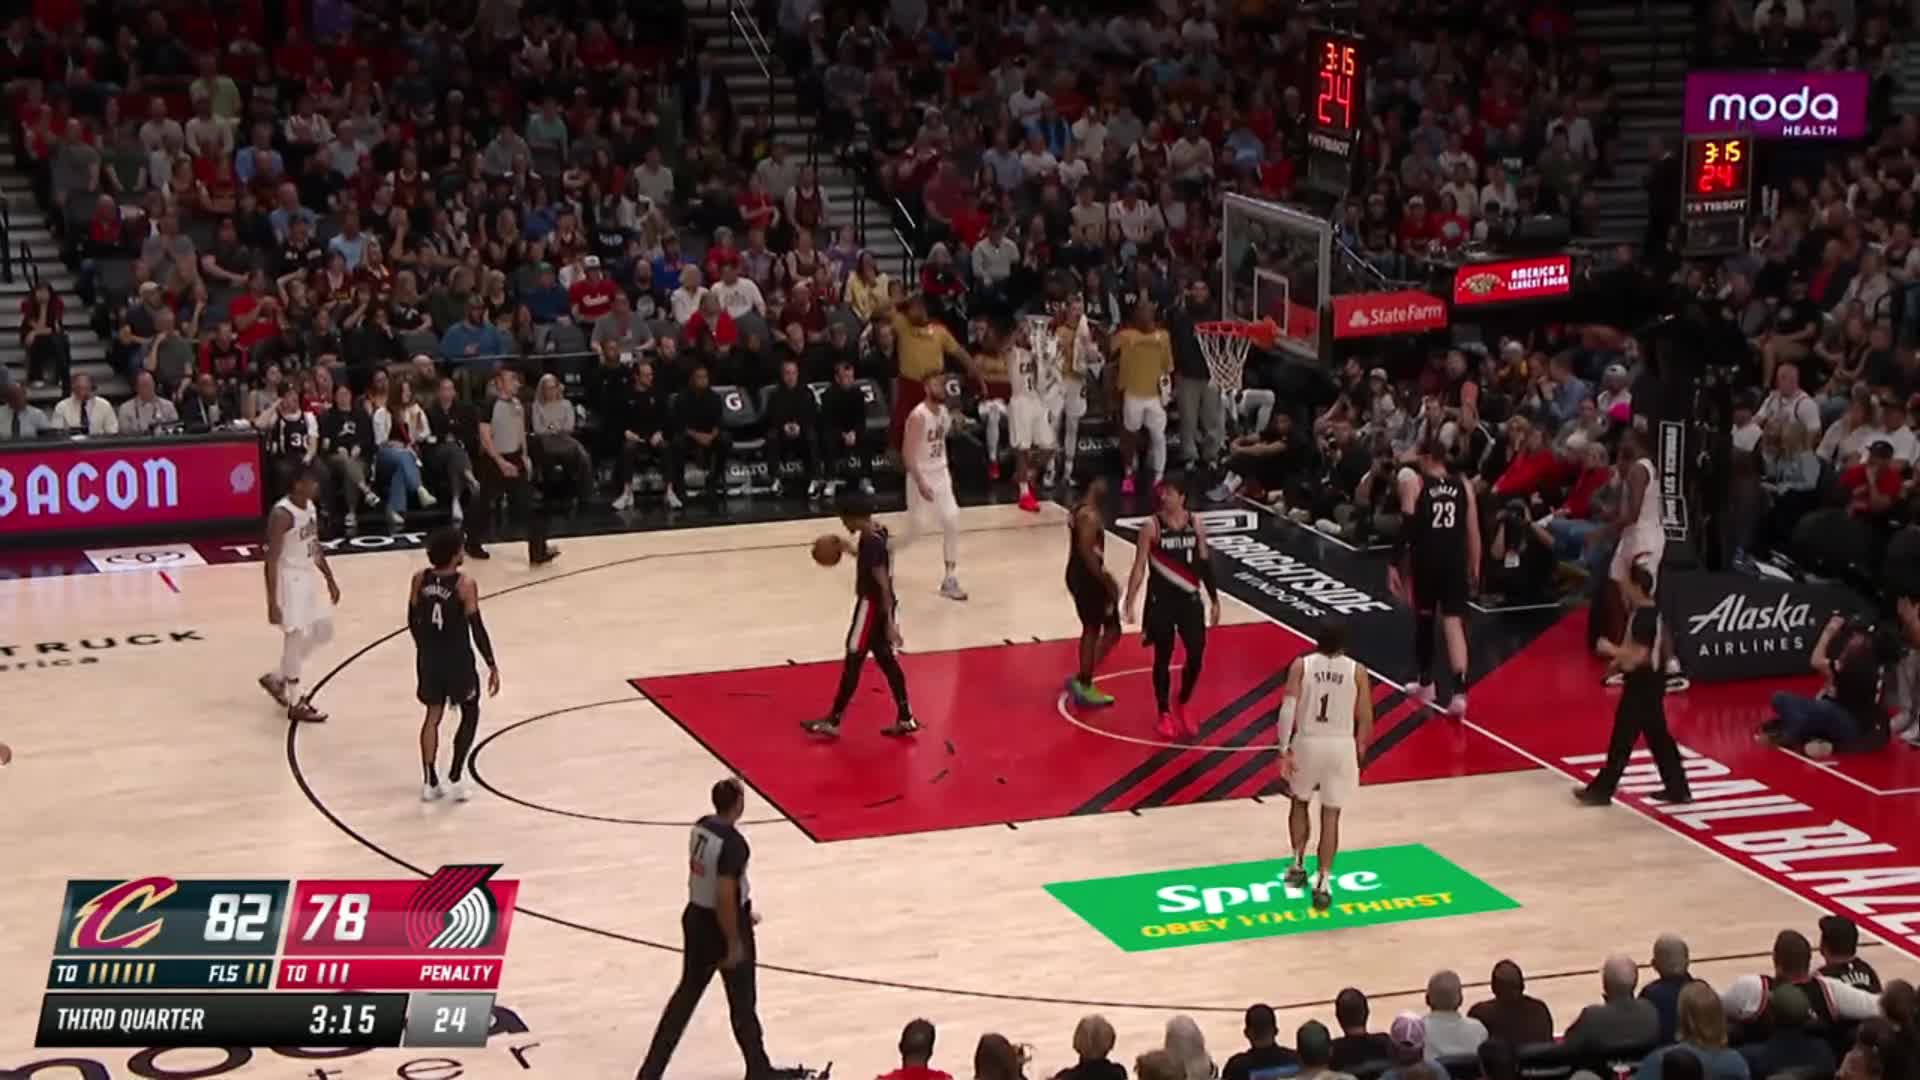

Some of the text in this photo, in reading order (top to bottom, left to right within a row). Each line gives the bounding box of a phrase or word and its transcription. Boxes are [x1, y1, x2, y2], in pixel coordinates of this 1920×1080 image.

[1325, 43, 1355, 76] 3:15
[1318, 71, 1351, 129] 24
[1708, 85, 1839, 121] moda
[1782, 125, 1838, 137] HEALTH
[1704, 140, 1742, 164] 3:15
[1699, 164, 1733, 192] 24
[1704, 200, 1746, 212] TISSOT
[725, 392, 743, 412] G
[945, 380, 961, 397] G
[0, 457, 179, 518] BACON
[1432, 501, 1456, 529] 23
[1205, 534, 1393, 615] BRIGHTSIDE
[431, 602, 444, 631] 4
[1687, 592, 1811, 635] Alaska
[1699, 636, 1804, 656] AIRLINES
[1315, 693, 1329, 723] 1
[1140, 917, 1230, 938] OBEY
[1337, 891, 1453, 915] THIRST
